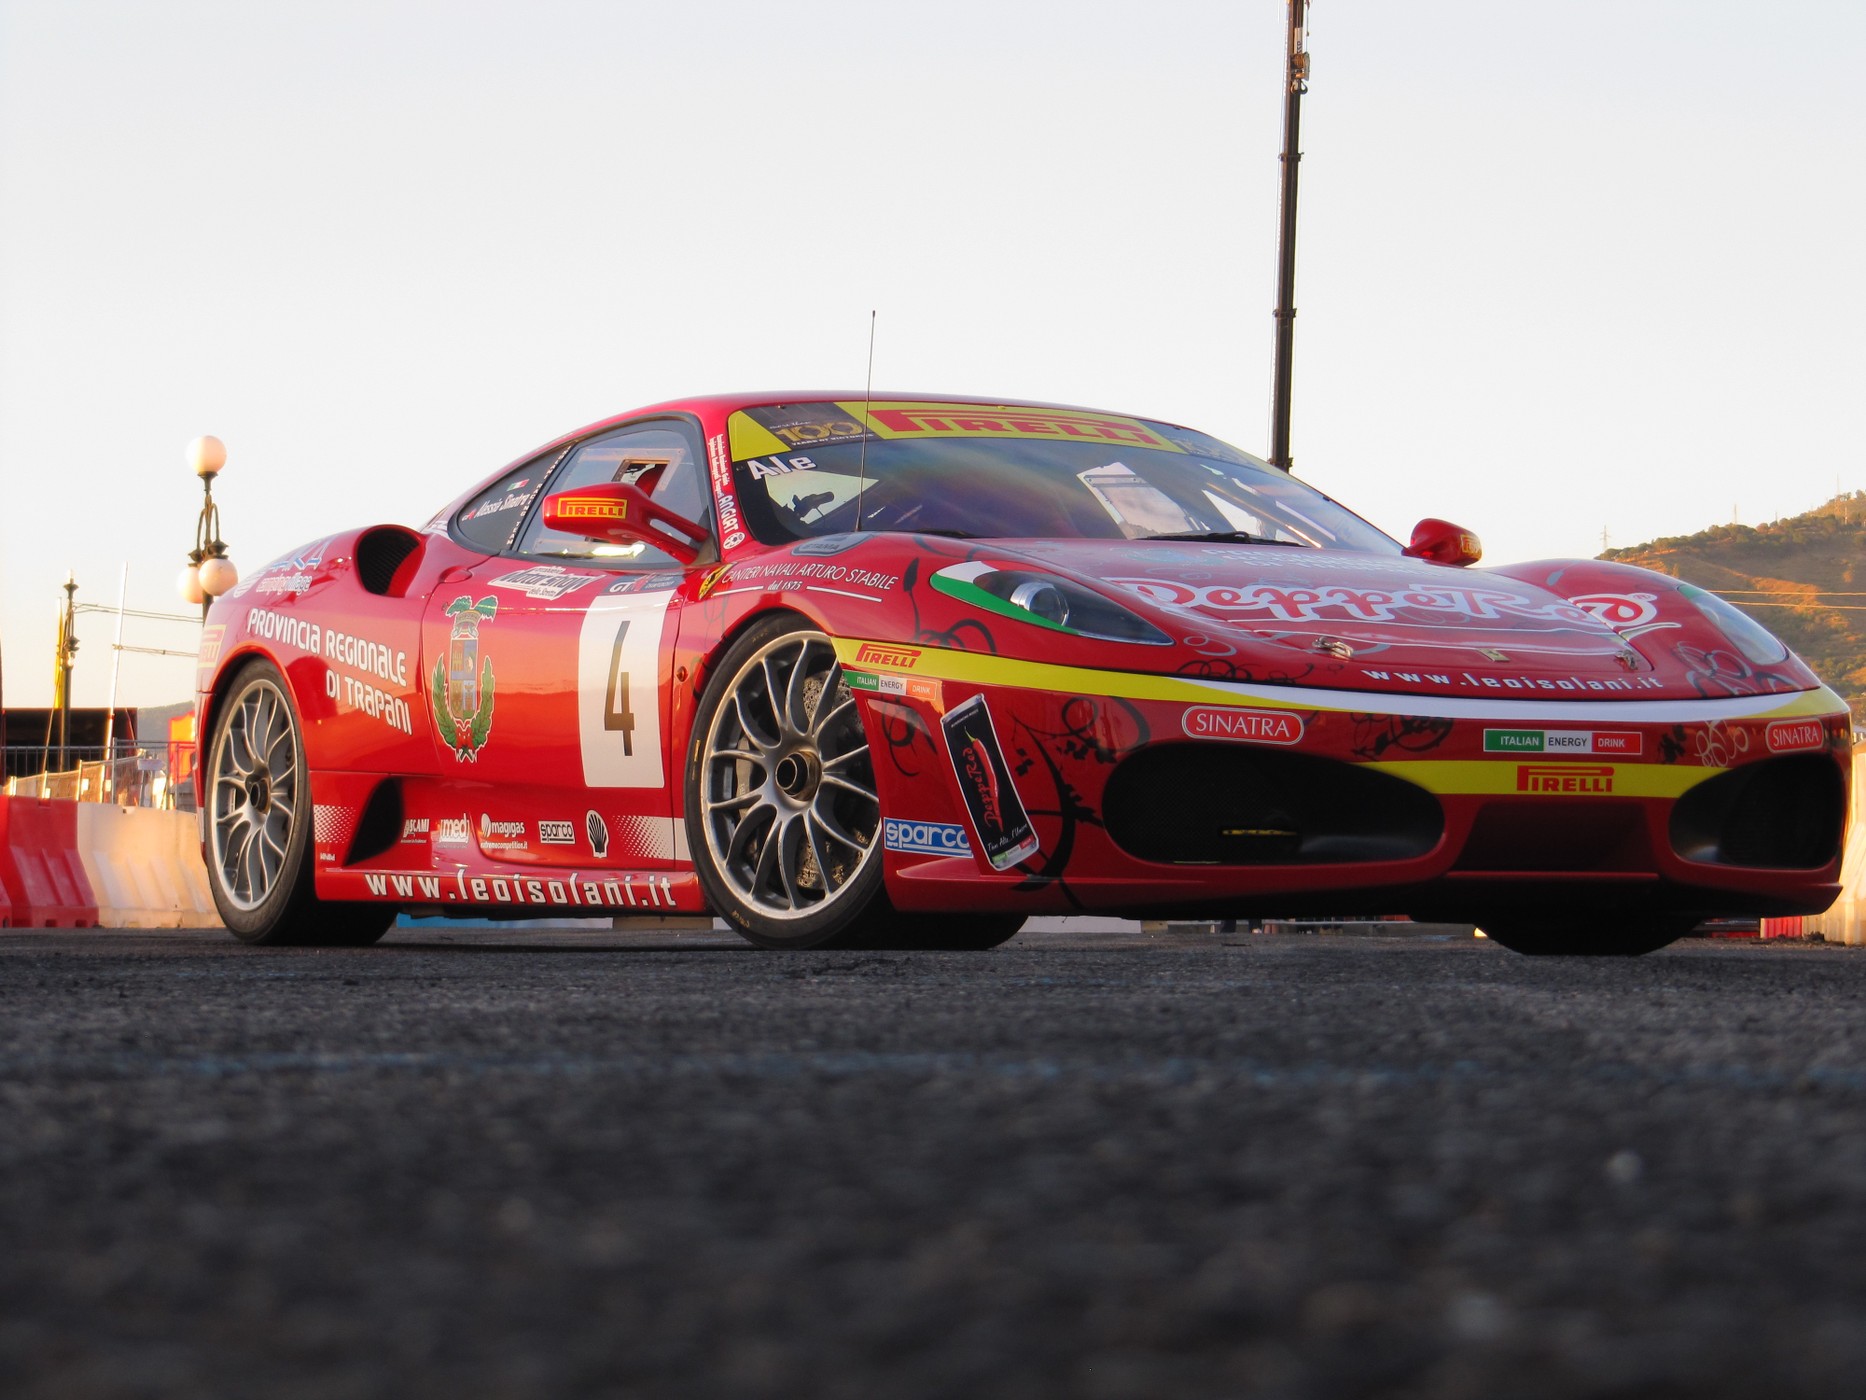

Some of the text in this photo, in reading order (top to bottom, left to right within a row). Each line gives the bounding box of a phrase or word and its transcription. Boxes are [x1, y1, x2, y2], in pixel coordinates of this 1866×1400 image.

[775, 422, 863, 442] 100
[866, 409, 1164, 446] PIRELLI
[747, 455, 817, 481] Ale
[557, 497, 627, 519] PIRELLI
[506, 521, 521, 545] TEAM
[721, 562, 899, 591] CANTIERI NAVALI ARTURO STABILE
[767, 580, 781, 591] dal
[855, 642, 922, 668] PIRELLI
[326, 669, 341, 700] DI
[604, 620, 635, 756] 4
[856, 675, 931, 694] ITALIAN ENERGY DRINK
[1360, 669, 1663, 691] www.leoisolani.it
[1195, 713, 1290, 738] SINATRA
[1773, 726, 1819, 747] SINATRA
[1500, 735, 1625, 748] ITALIAN ENERGY DRINK
[1517, 765, 1615, 793] PIRELLI
[540, 823, 575, 842] sparco
[364, 868, 677, 907] www.leoisolani.it
